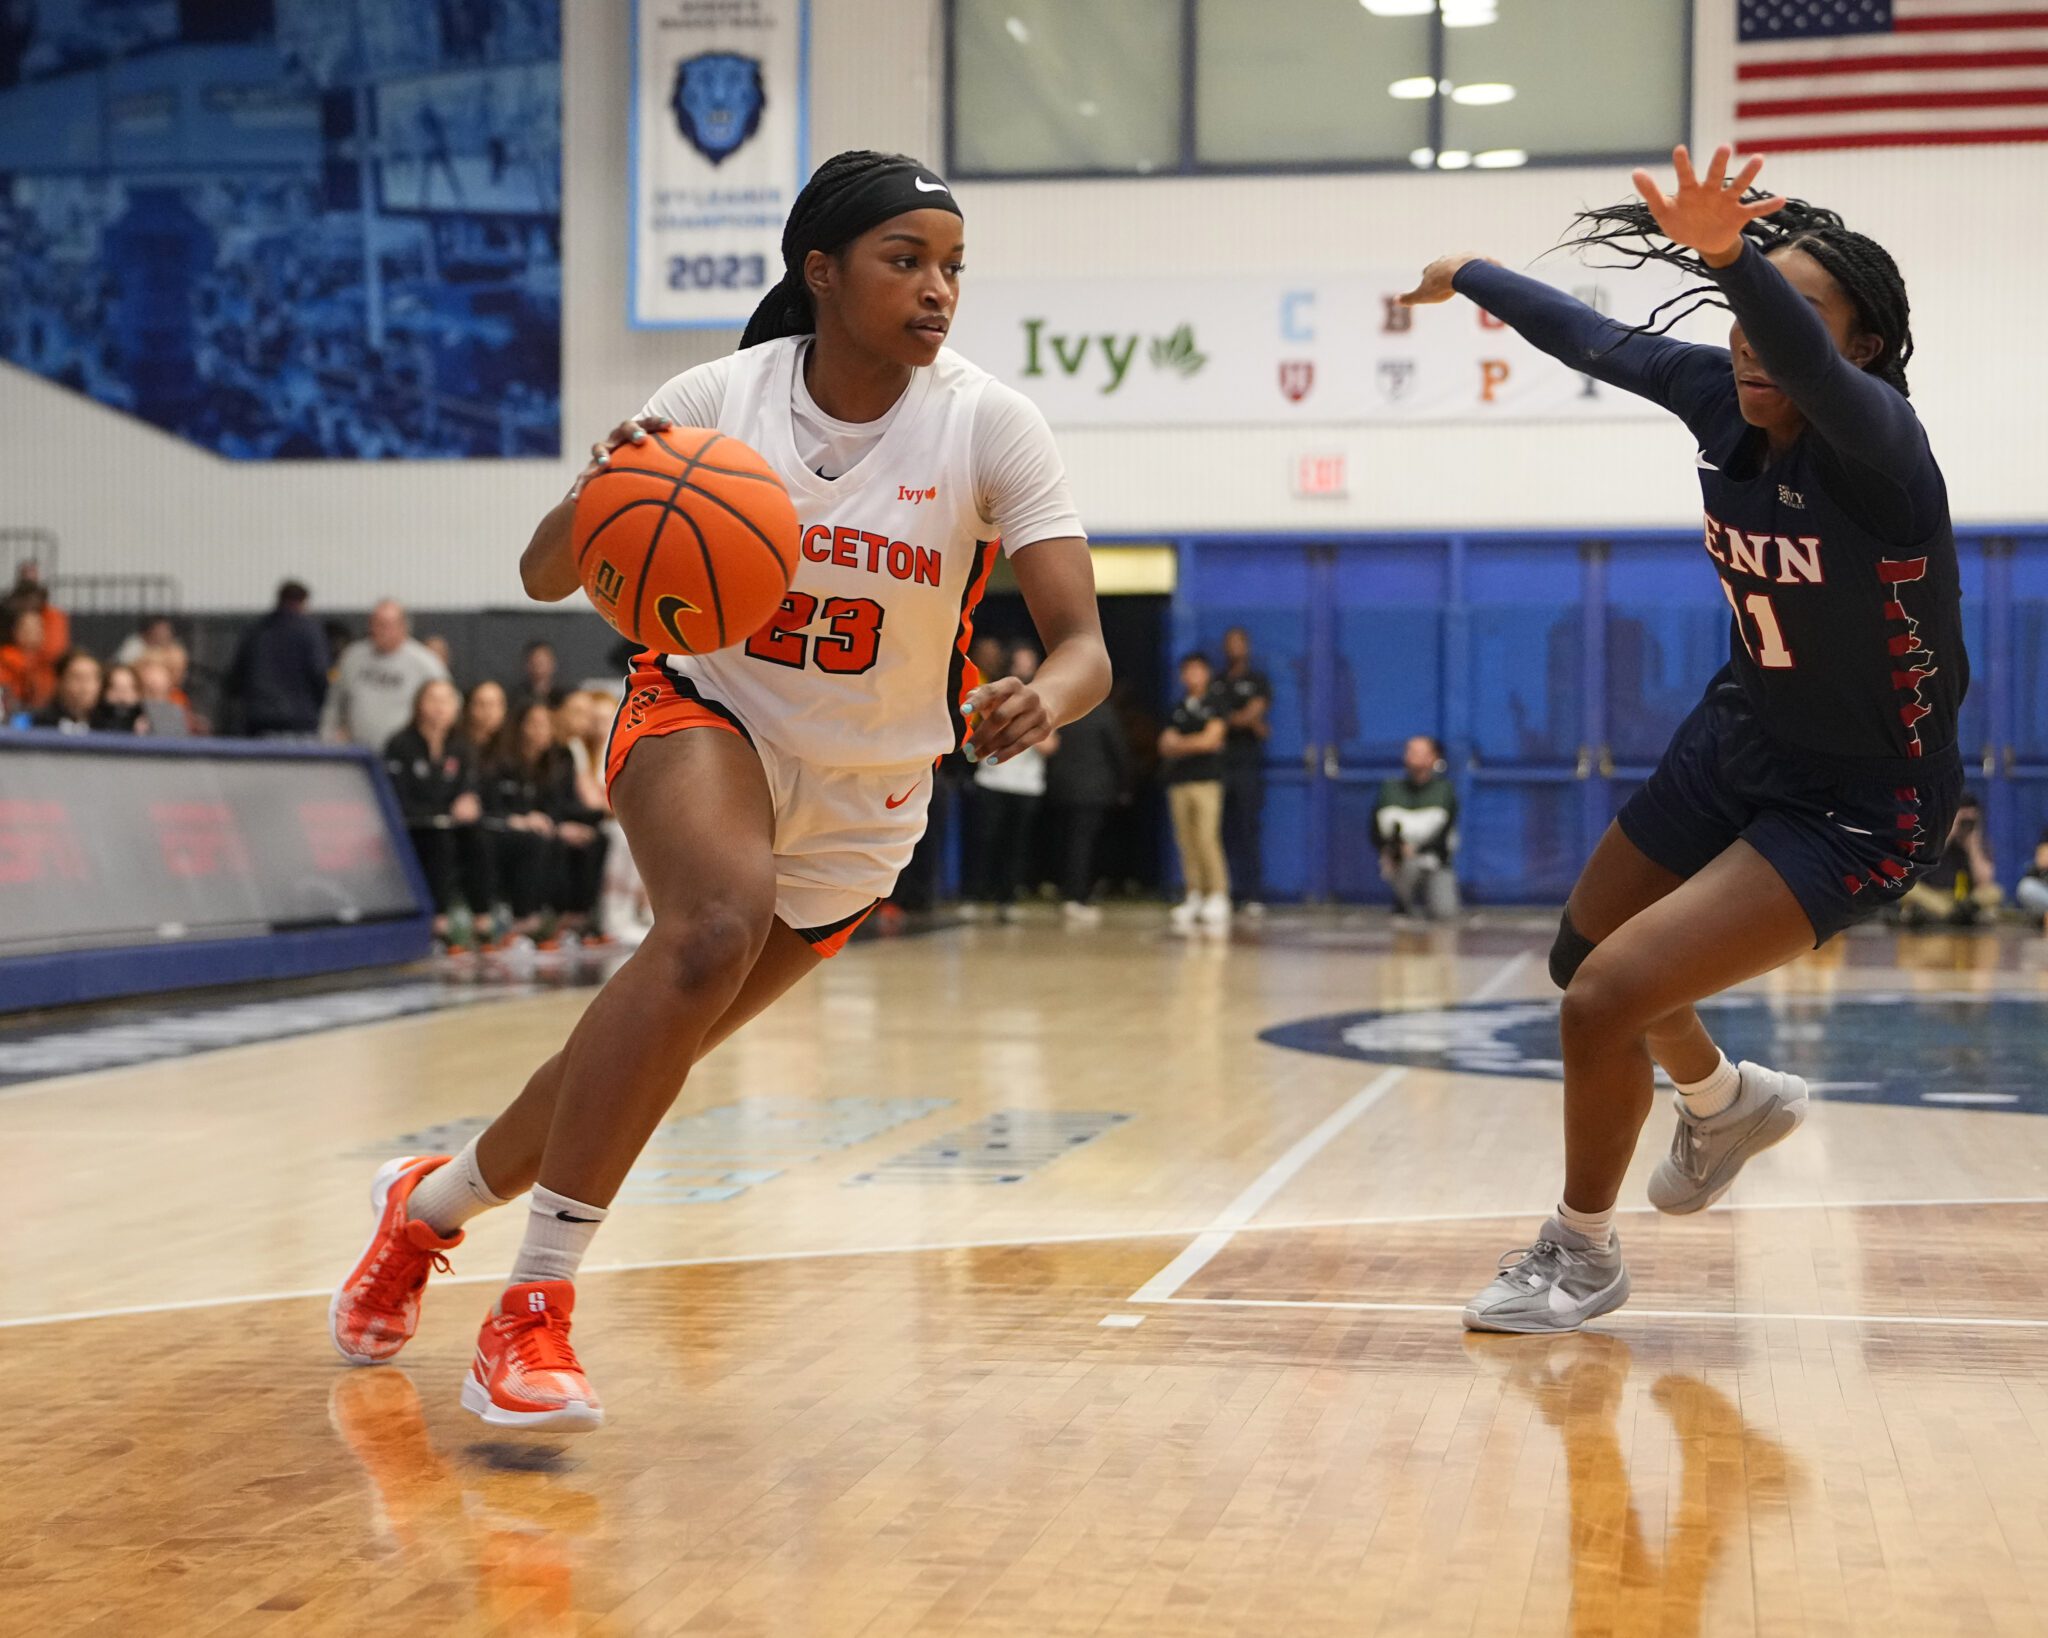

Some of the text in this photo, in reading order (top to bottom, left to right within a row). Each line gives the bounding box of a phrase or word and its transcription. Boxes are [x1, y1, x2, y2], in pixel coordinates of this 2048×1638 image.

[669, 255, 766, 290] 2023
[1021, 318, 1139, 395] Ivy
[1480, 359, 1511, 402] P
[897, 485, 924, 505] Ivy
[798, 524, 942, 588] CETON
[1703, 511, 1825, 585] ENN
[744, 591, 885, 675] 23
